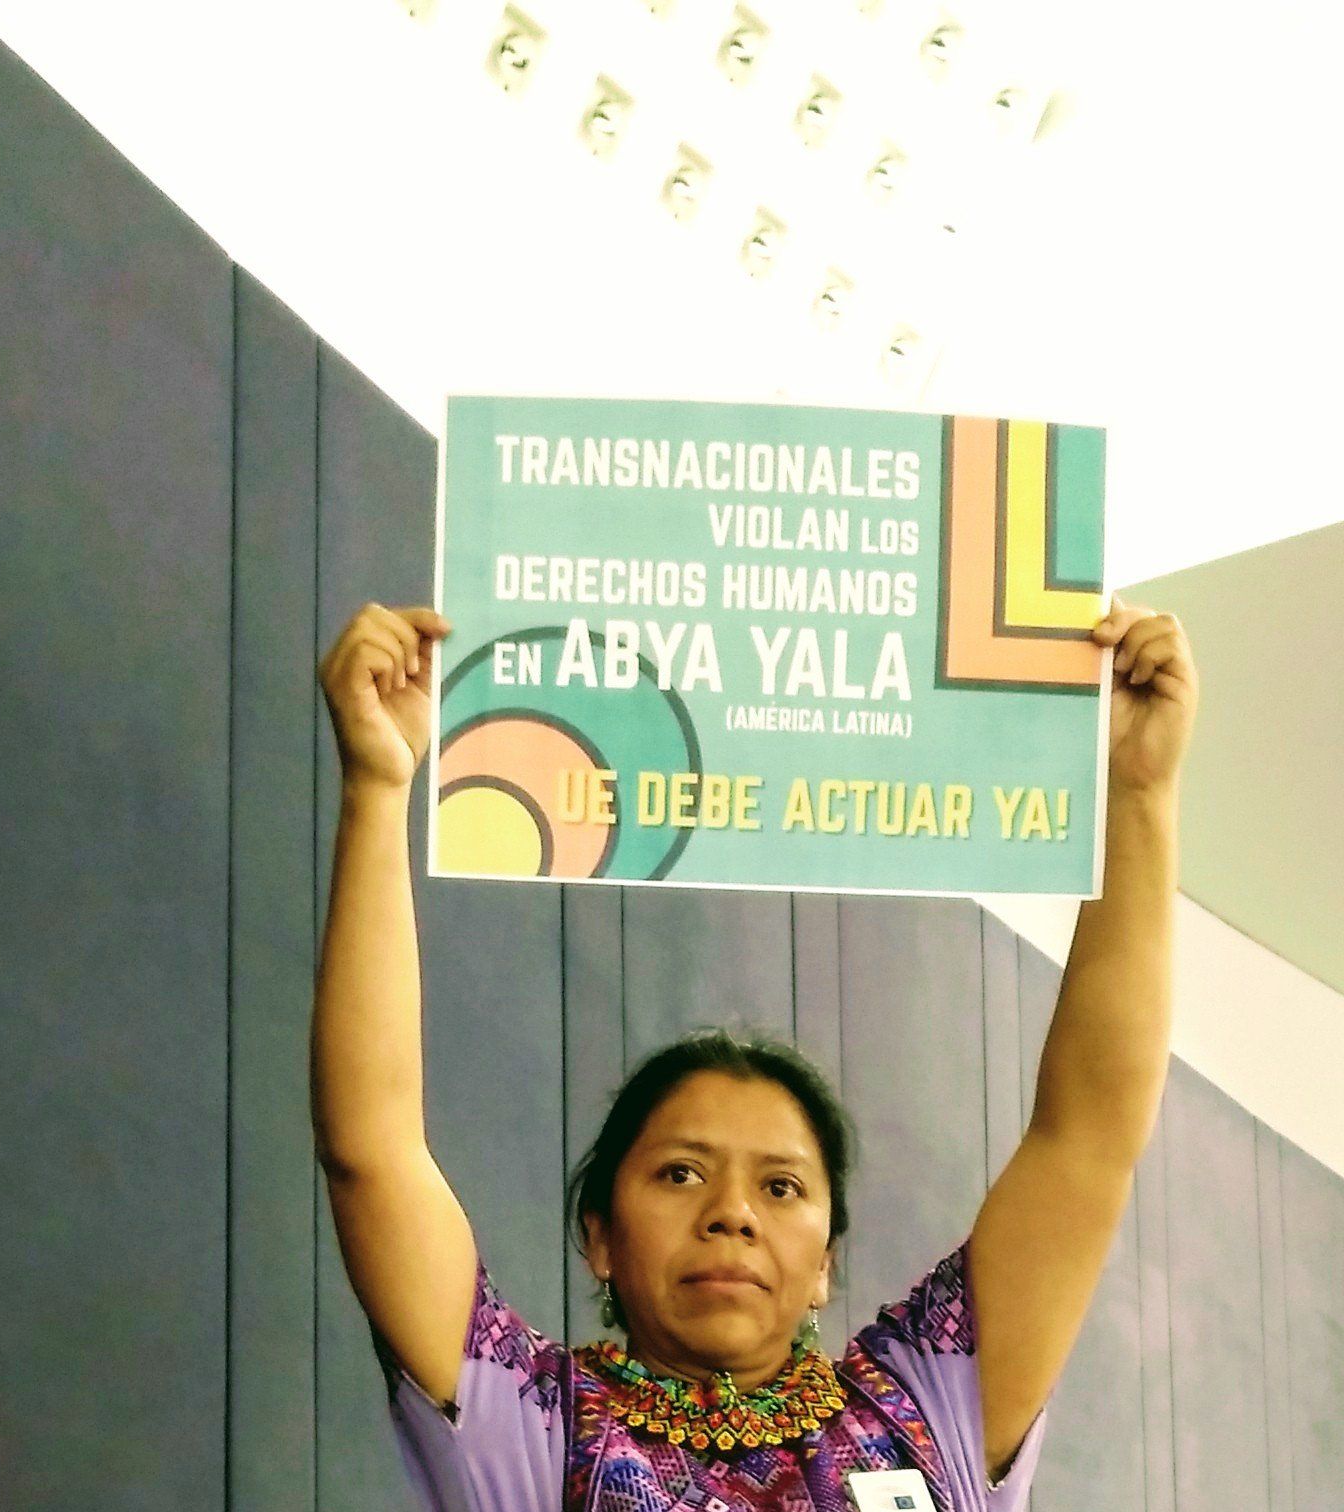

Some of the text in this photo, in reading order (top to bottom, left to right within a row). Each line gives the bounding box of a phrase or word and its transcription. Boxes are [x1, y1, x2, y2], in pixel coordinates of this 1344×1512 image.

[495, 435, 920, 500] TRANSNACIONALES
[708, 503, 919, 556] VIOLAN LOS
[494, 555, 918, 617] DERECHOS HUMANOS
[493, 617, 912, 701] EN ABYA YALA
[726, 701, 912, 739] (AMÉRICA LATINA)
[556, 767, 1071, 842] UE DEBE ACTUAR YA!
